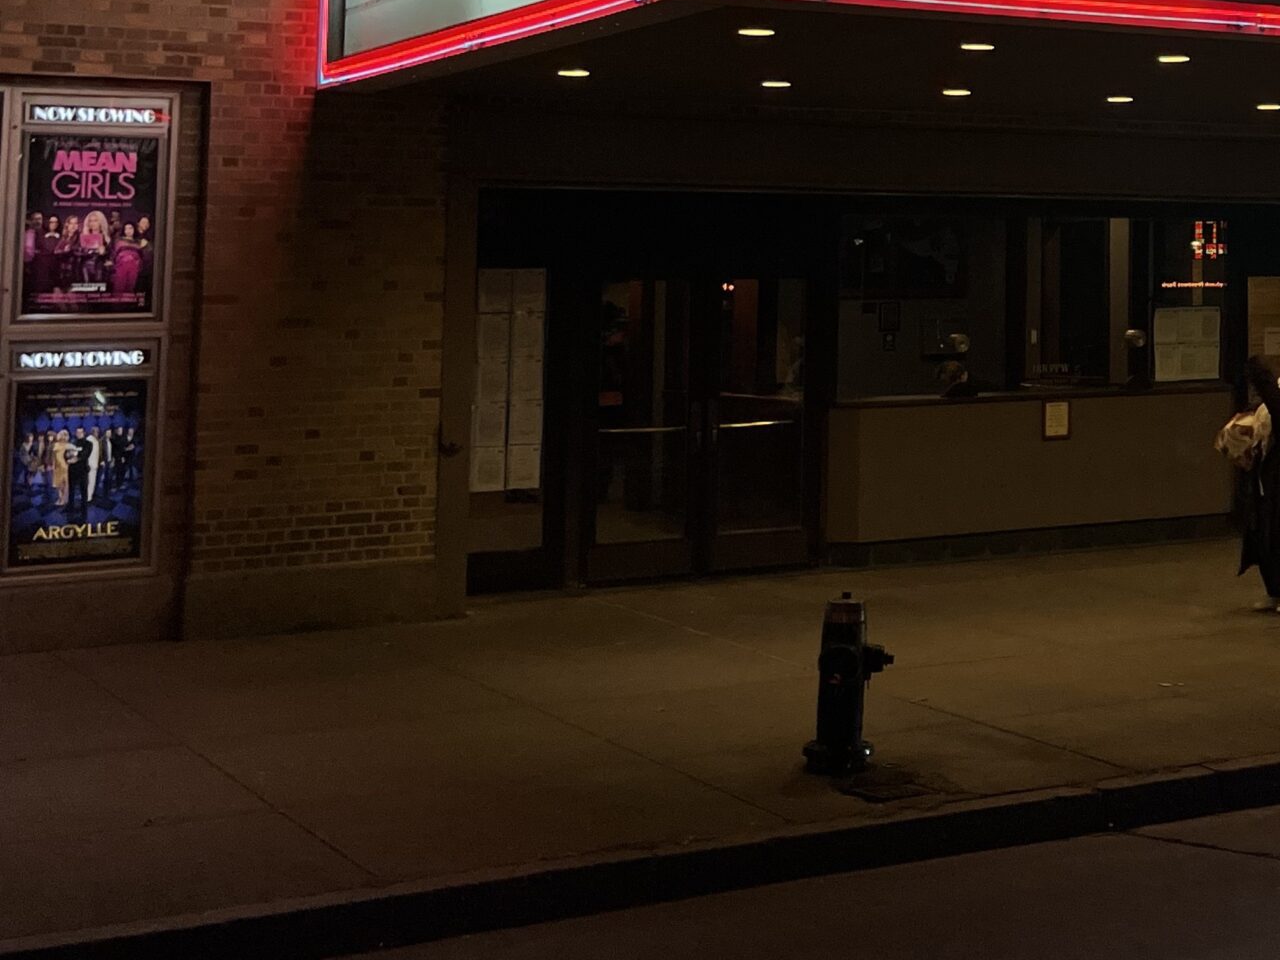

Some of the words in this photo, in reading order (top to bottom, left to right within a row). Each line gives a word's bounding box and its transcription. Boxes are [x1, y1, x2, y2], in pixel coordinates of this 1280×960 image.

[33, 106, 76, 121] NOW
[78, 107, 156, 123] SHOWING
[53, 150, 137, 172] MEAN
[51, 171, 135, 200] GIRLS
[20, 352, 63, 368] NOW
[64, 350, 144, 367] SHOWING
[33, 521, 120, 540] ARGYLLE
